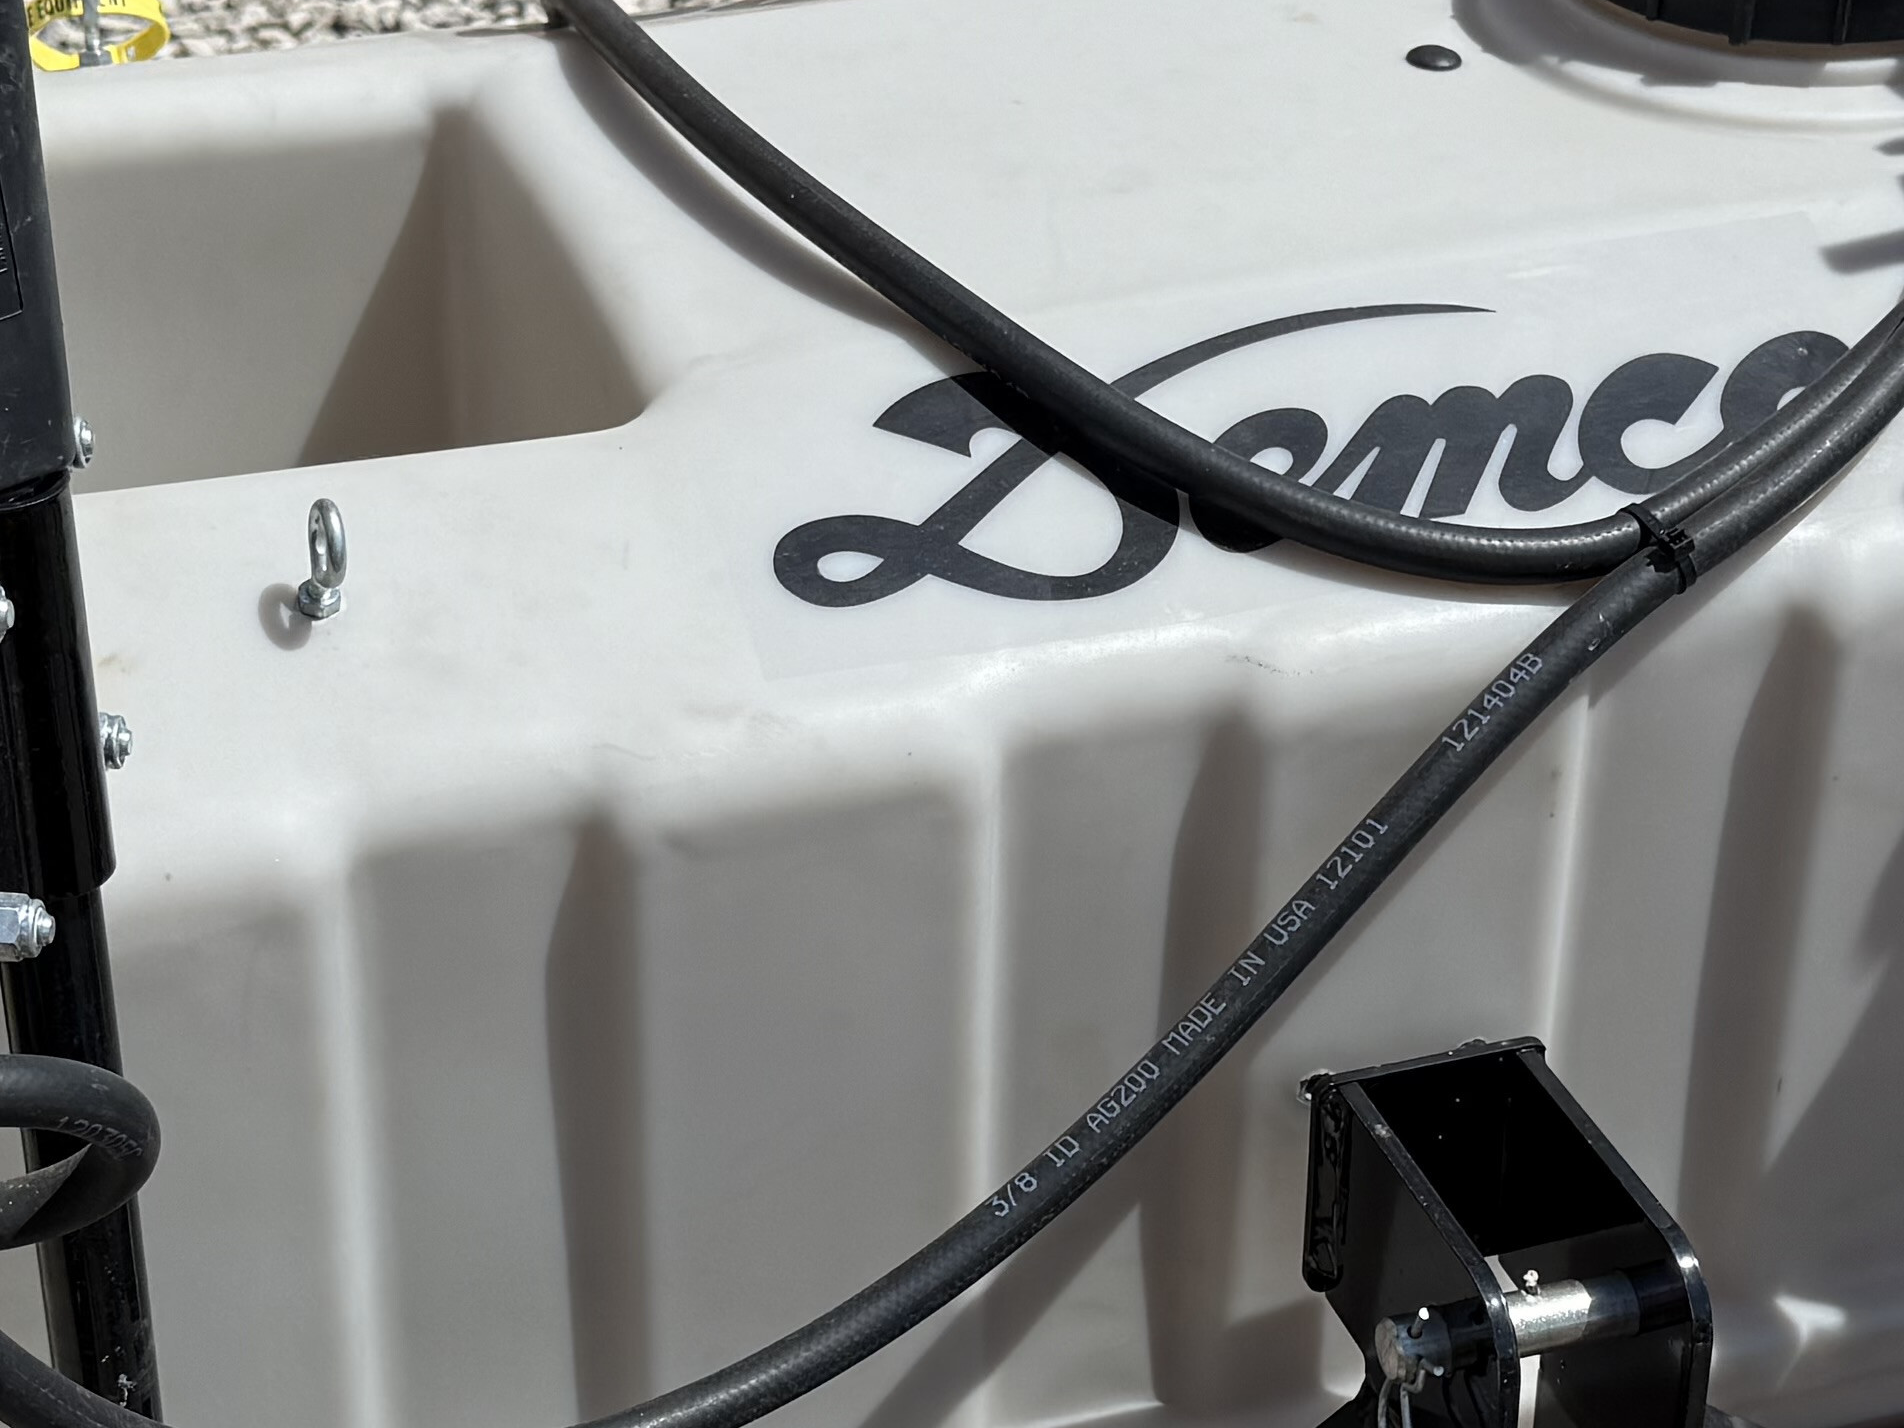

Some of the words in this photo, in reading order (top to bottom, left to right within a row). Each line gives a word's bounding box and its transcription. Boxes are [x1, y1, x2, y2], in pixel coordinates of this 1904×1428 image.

[989, 1171, 1039, 1218] 3/8
[1043, 1134, 1081, 1170] ID
[1084, 1059, 1161, 1134] AG200
[1162, 994, 1228, 1057] MADE
[1229, 950, 1266, 988] IN
[1264, 897, 1317, 949] USA
[1315, 817, 1389, 890] 12101
[1441, 650, 1544, 754] 121404B
